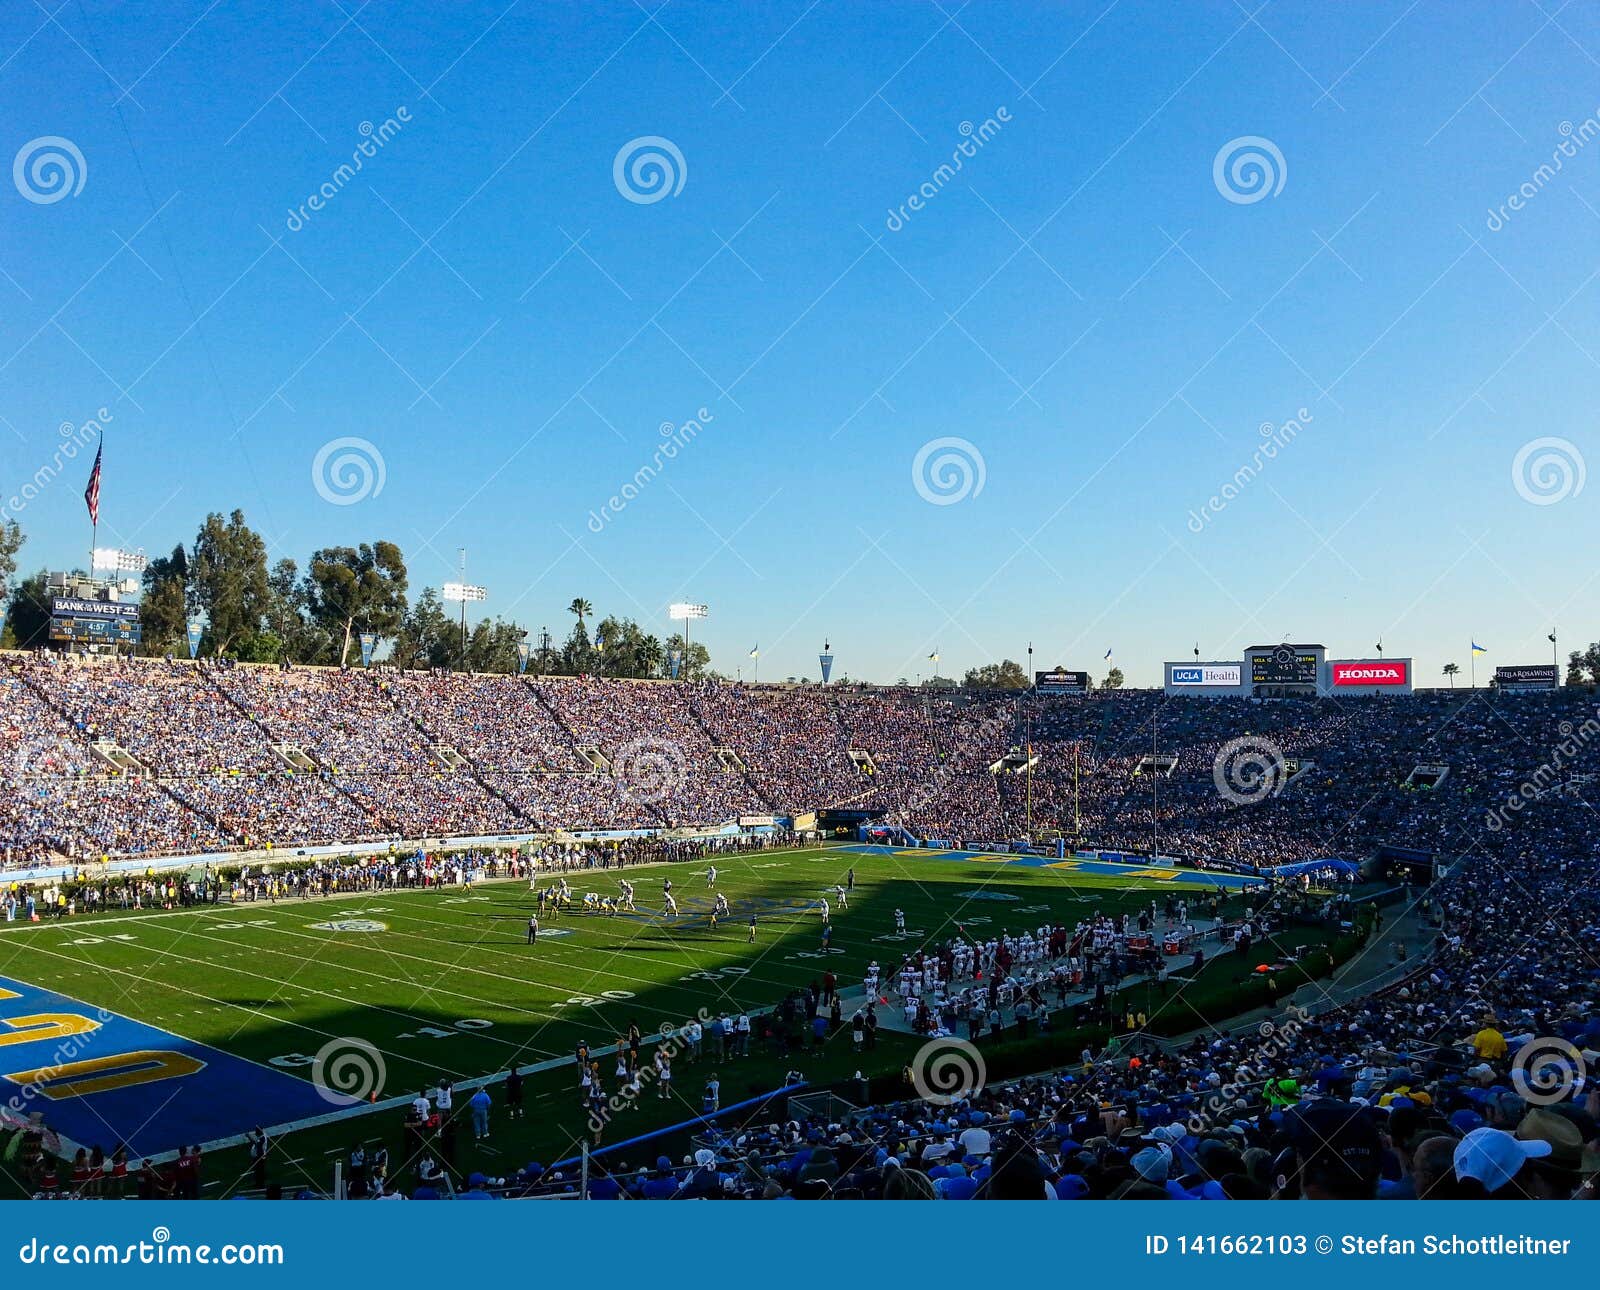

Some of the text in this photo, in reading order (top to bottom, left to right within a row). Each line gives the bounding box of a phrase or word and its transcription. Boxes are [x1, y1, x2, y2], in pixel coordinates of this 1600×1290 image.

[55, 601, 84, 611] BANK
[93, 604, 122, 614] WEST
[88, 623, 105, 631] 4:57
[120, 631, 130, 639] 28
[1176, 671, 1238, 681] UCLA Health
[1338, 669, 1400, 679] HONDA
[1284, 761, 1297, 771] 24
[739, 817, 774, 825] HONDA
[565, 990, 637, 1008] 20
[414, 1018, 495, 1040] 10
